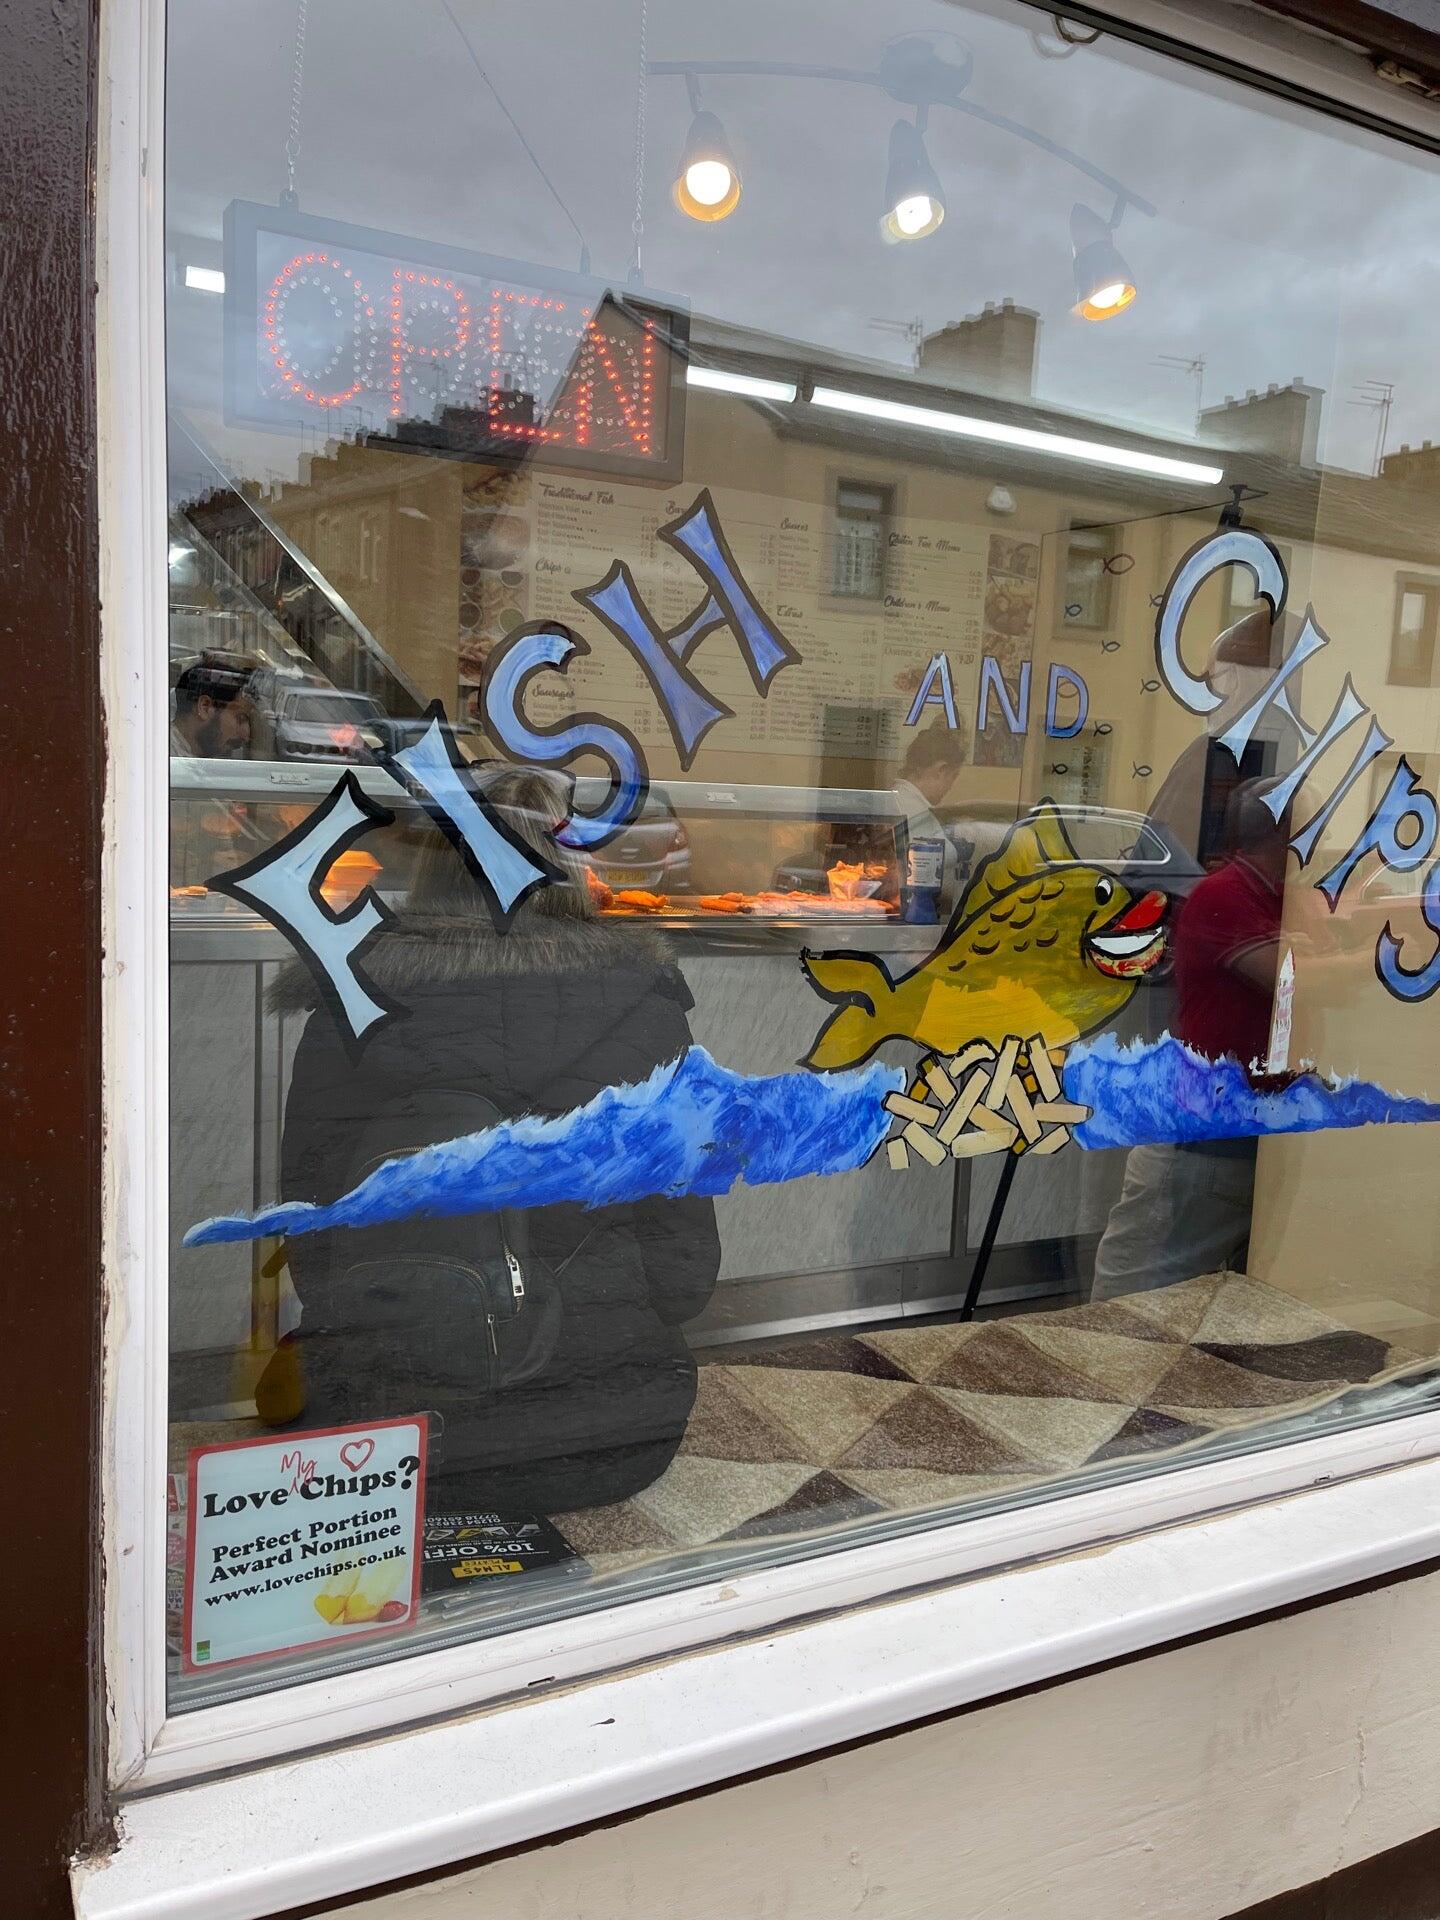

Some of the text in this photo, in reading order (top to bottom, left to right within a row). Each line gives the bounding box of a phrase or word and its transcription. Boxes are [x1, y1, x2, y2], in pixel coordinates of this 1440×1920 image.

[262, 252, 656, 455] OPEN
[204, 488, 803, 1042] FISH
[902, 650, 1089, 739] AND
[203, 1455, 421, 1518] Love Chips?
[281, 1450, 318, 1485] My
[209, 1547, 294, 1584] Award
[301, 1524, 402, 1560] Nominee
[212, 1528, 302, 1564] Perfect
[309, 1507, 398, 1539] Portion
[424, 1546, 478, 1560] OFF!
[484, 1542, 535, 1554] 10%
[204, 1545, 407, 1607] www.lovechips.co.uk
